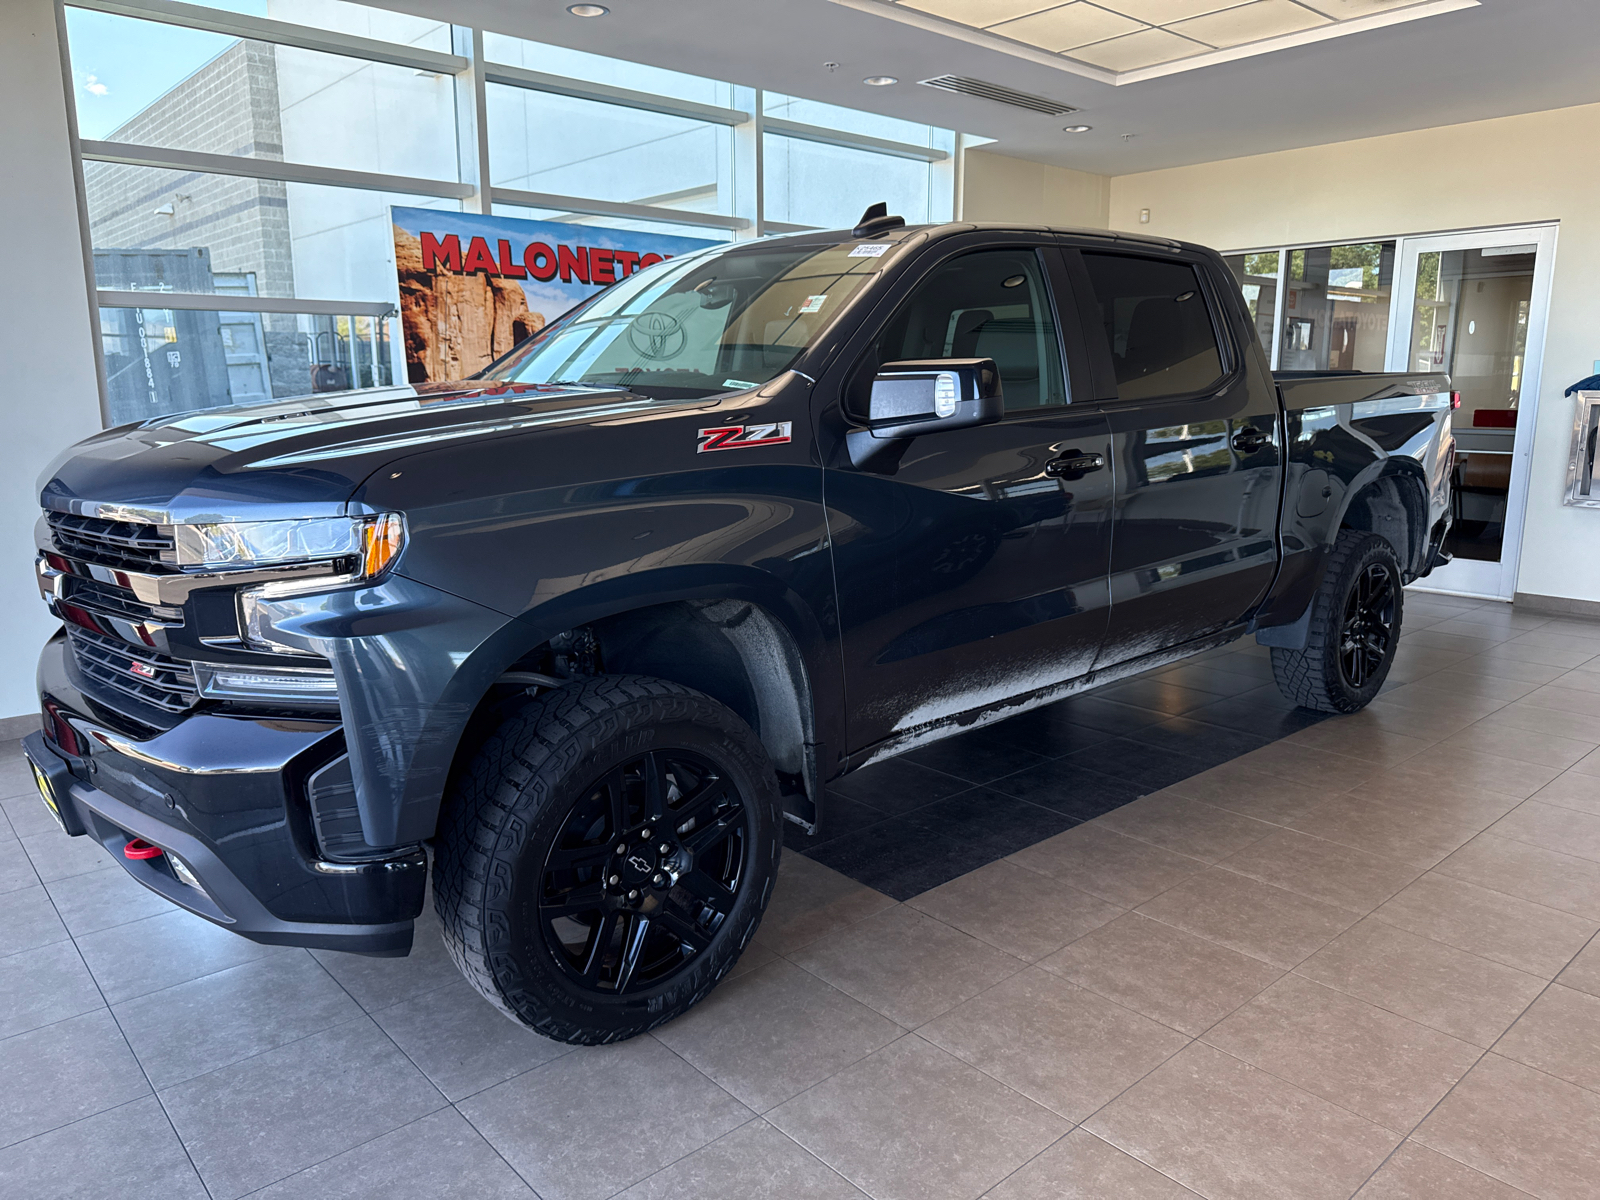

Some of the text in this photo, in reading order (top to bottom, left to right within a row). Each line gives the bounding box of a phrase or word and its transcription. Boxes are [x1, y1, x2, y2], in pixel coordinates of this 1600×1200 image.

[420, 231, 674, 286] MALONET
[697, 421, 792, 453] Z71
[130, 661, 155, 678] Z71
